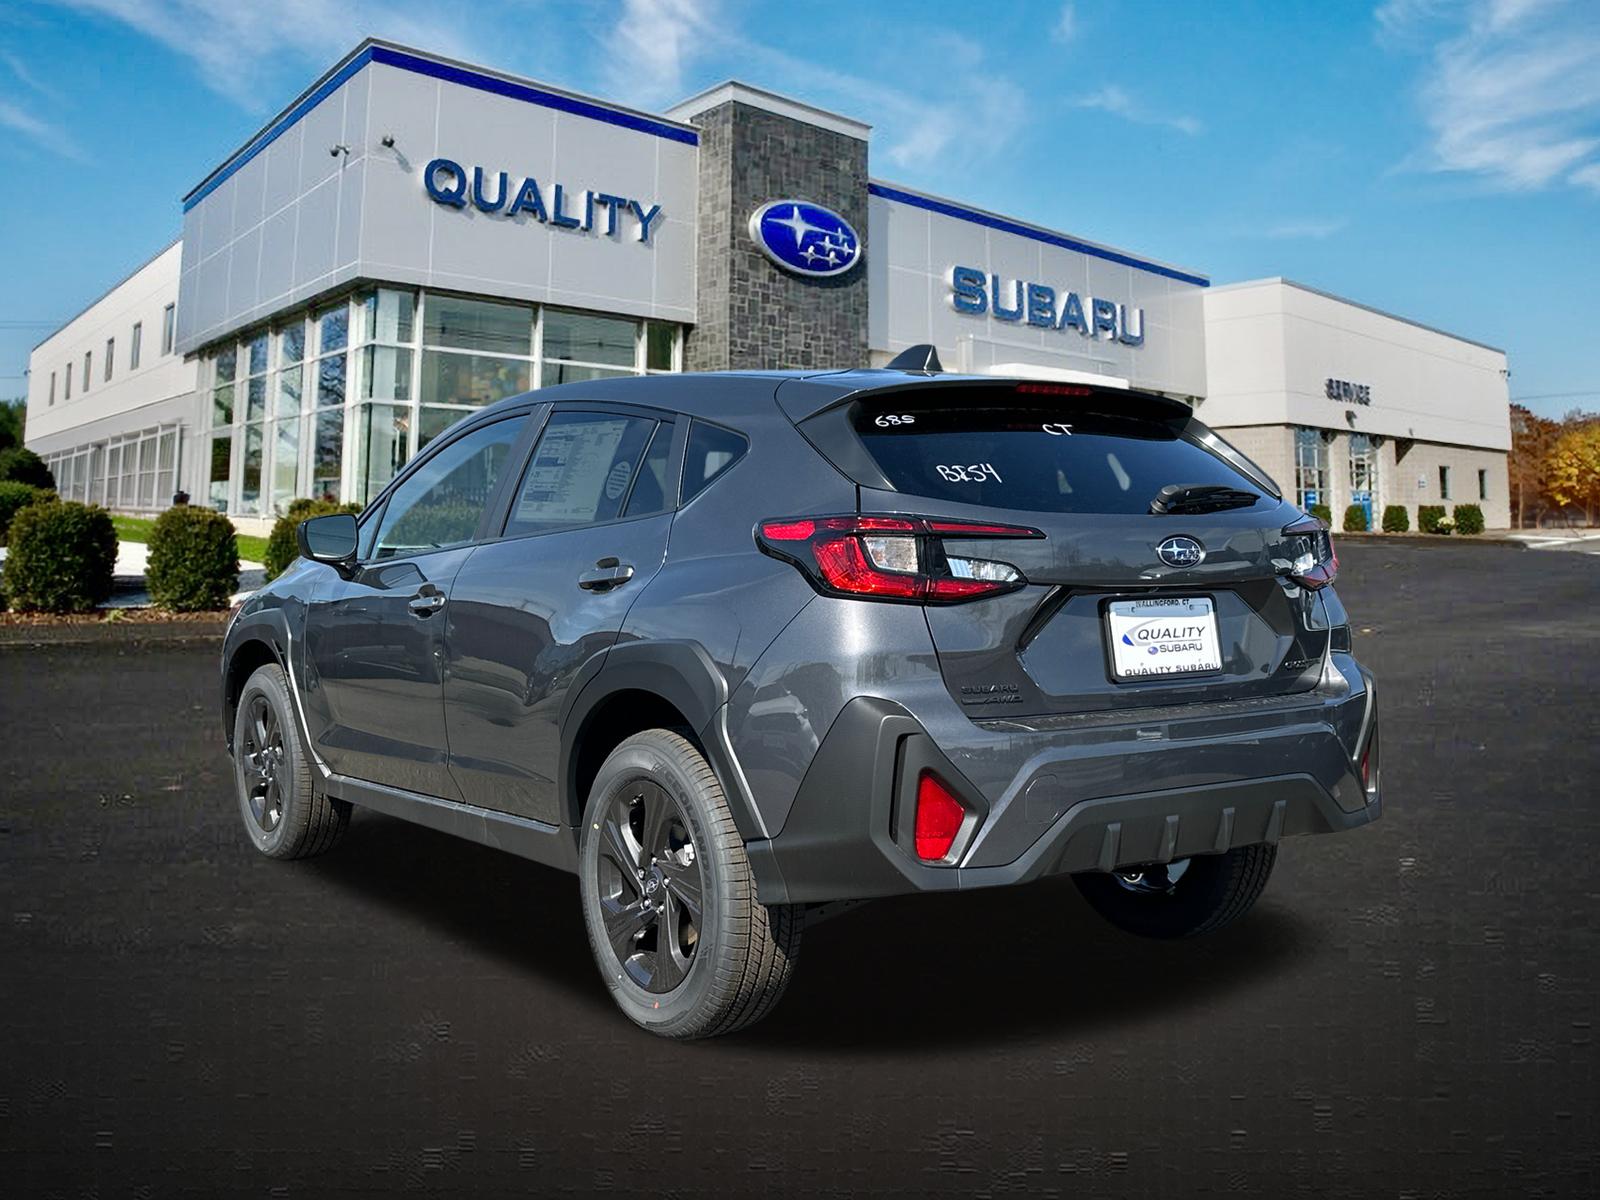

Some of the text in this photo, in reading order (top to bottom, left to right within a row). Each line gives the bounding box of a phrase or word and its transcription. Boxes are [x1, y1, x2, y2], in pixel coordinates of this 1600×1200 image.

[423, 157, 662, 243] QUALITY
[949, 265, 1146, 347] SUBARU
[1325, 378, 1371, 407] SERVICE
[1042, 423, 1073, 436] CT
[1137, 626, 1206, 640] QUALITY
[1160, 643, 1203, 653] SUBARU
[1125, 663, 1218, 676] QUALITY SUBARU
[961, 684, 1019, 695] SUBARU
